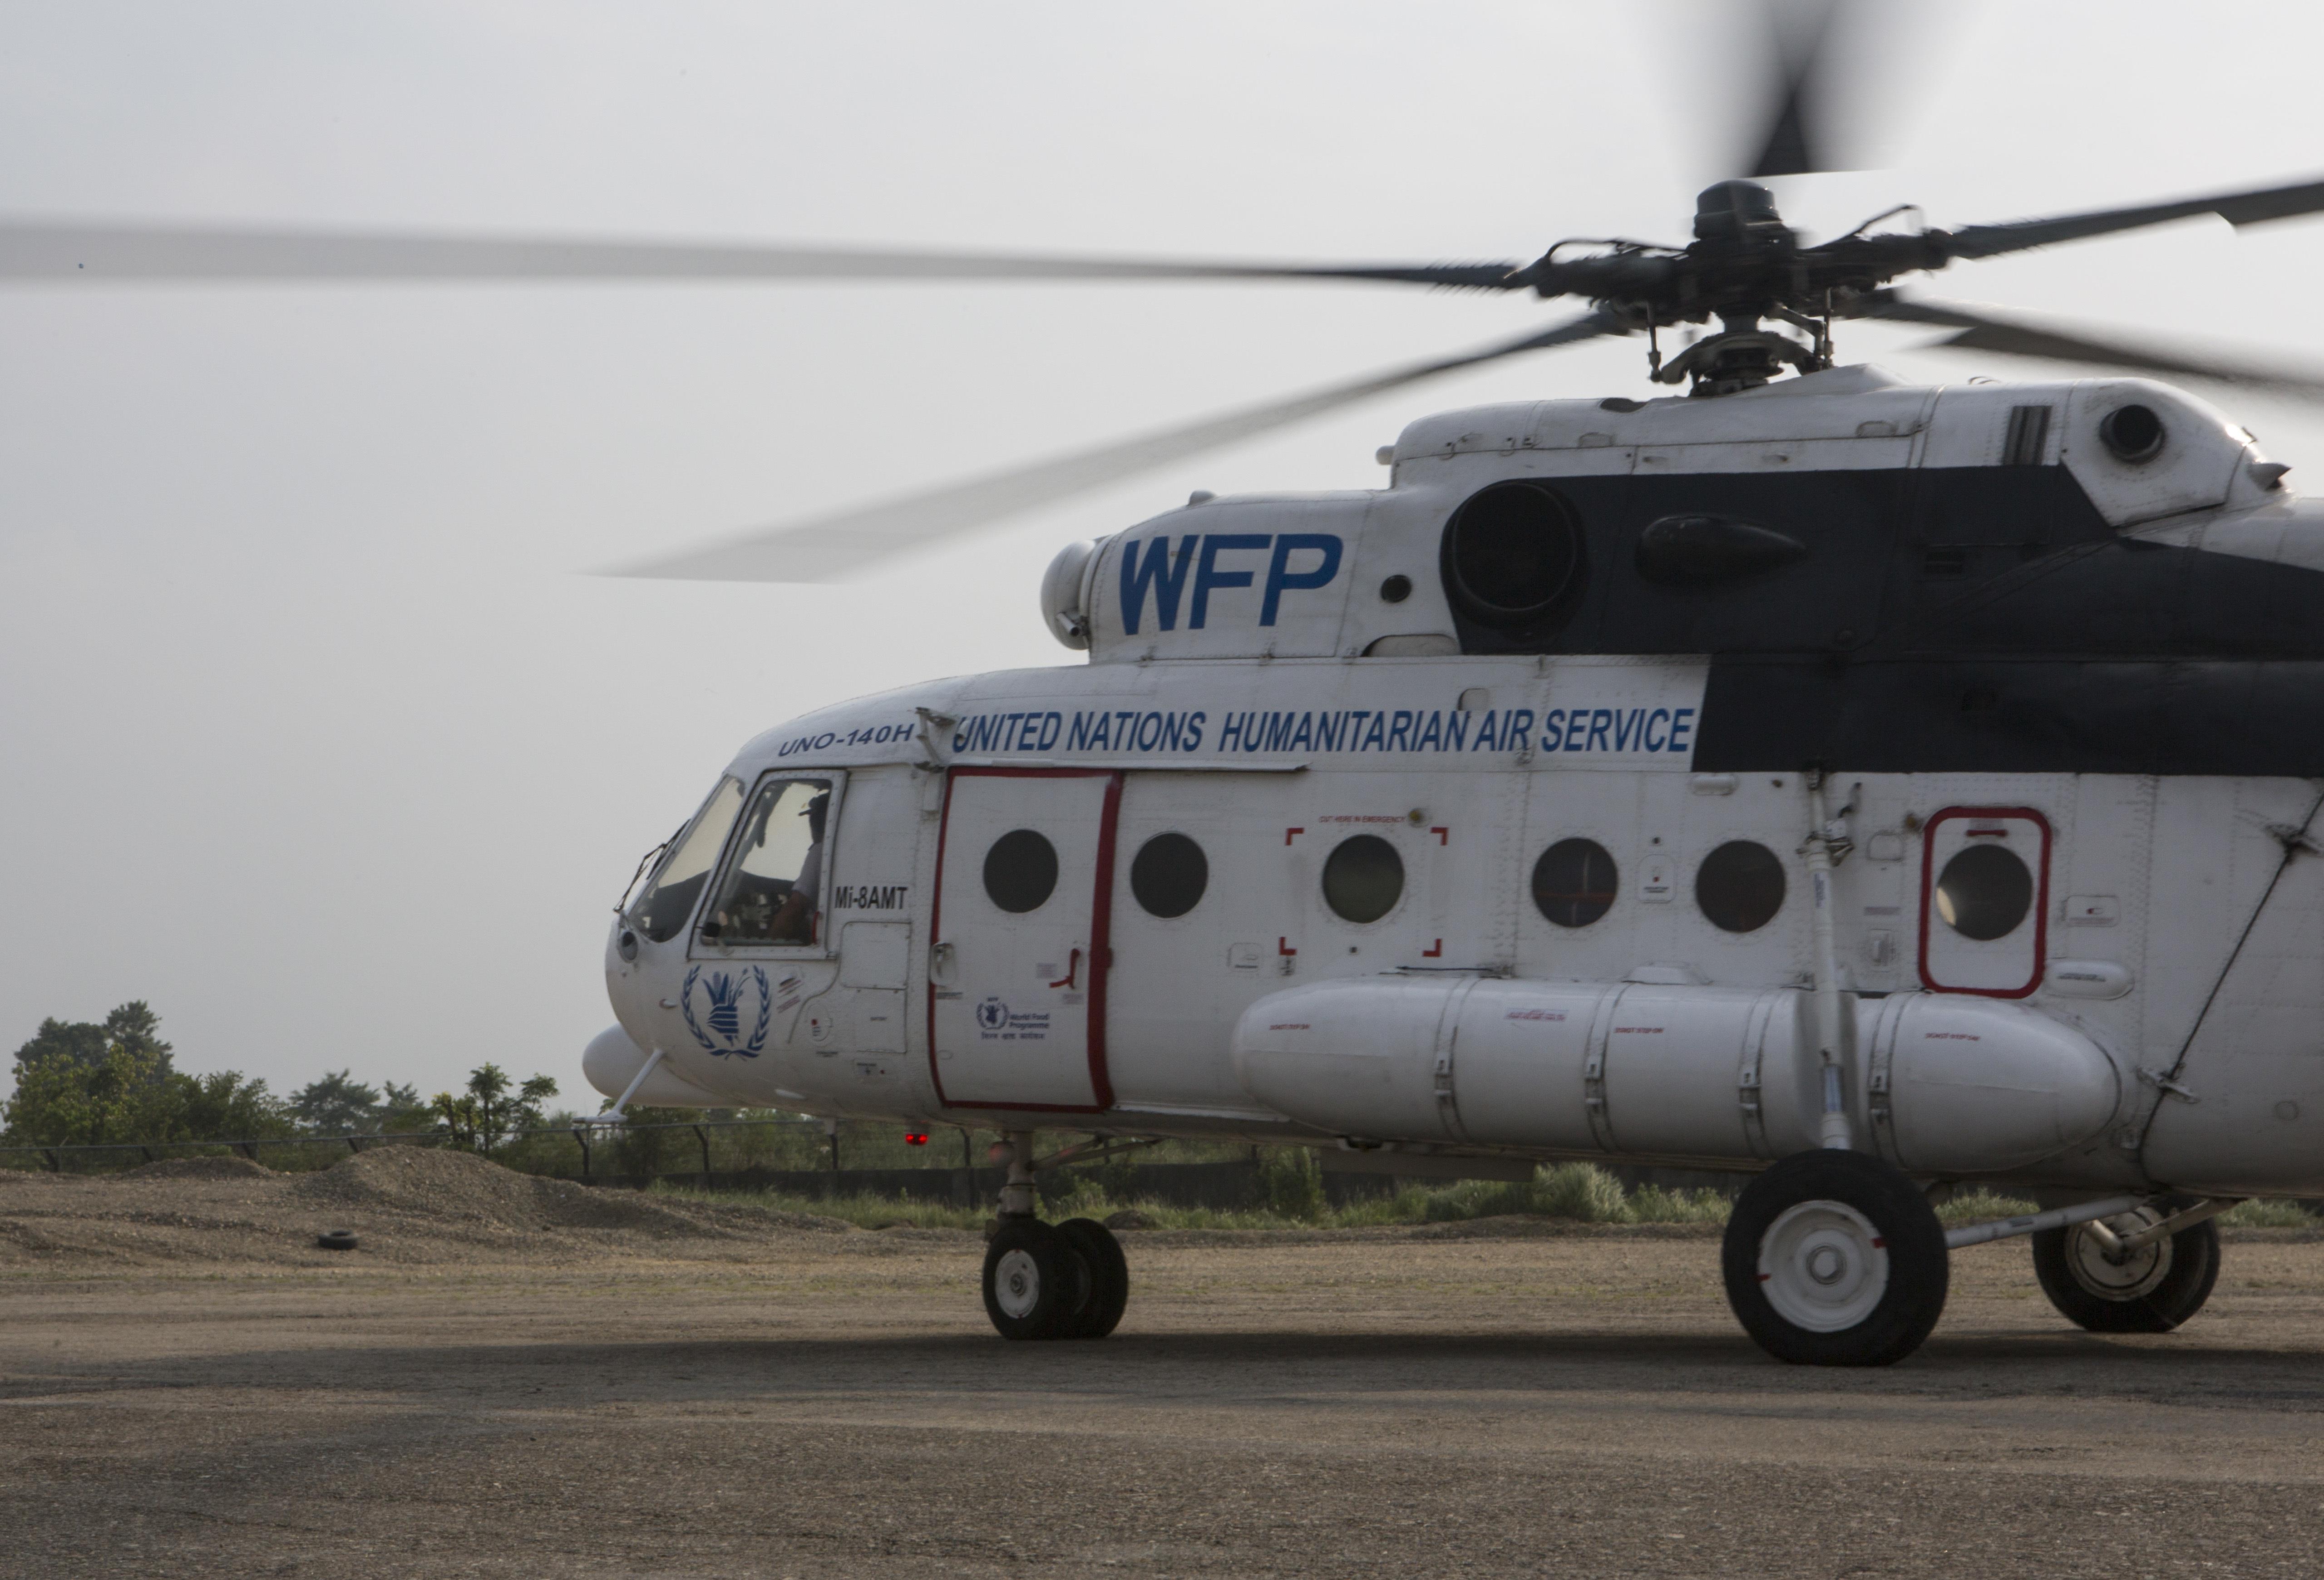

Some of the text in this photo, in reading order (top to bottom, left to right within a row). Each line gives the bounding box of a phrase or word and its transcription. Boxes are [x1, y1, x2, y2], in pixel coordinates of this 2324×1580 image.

[1120, 533, 1343, 635] WFP
[779, 723, 915, 757] UNO-140H
[952, 707, 1695, 752] UNITED NATIONS HUMANITARIAN AIR SERVICE
[835, 886, 908, 909] Mi-8AMT
[1009, 1013, 1050, 1021] World Food
[1009, 1021, 1050, 1030] Programme
